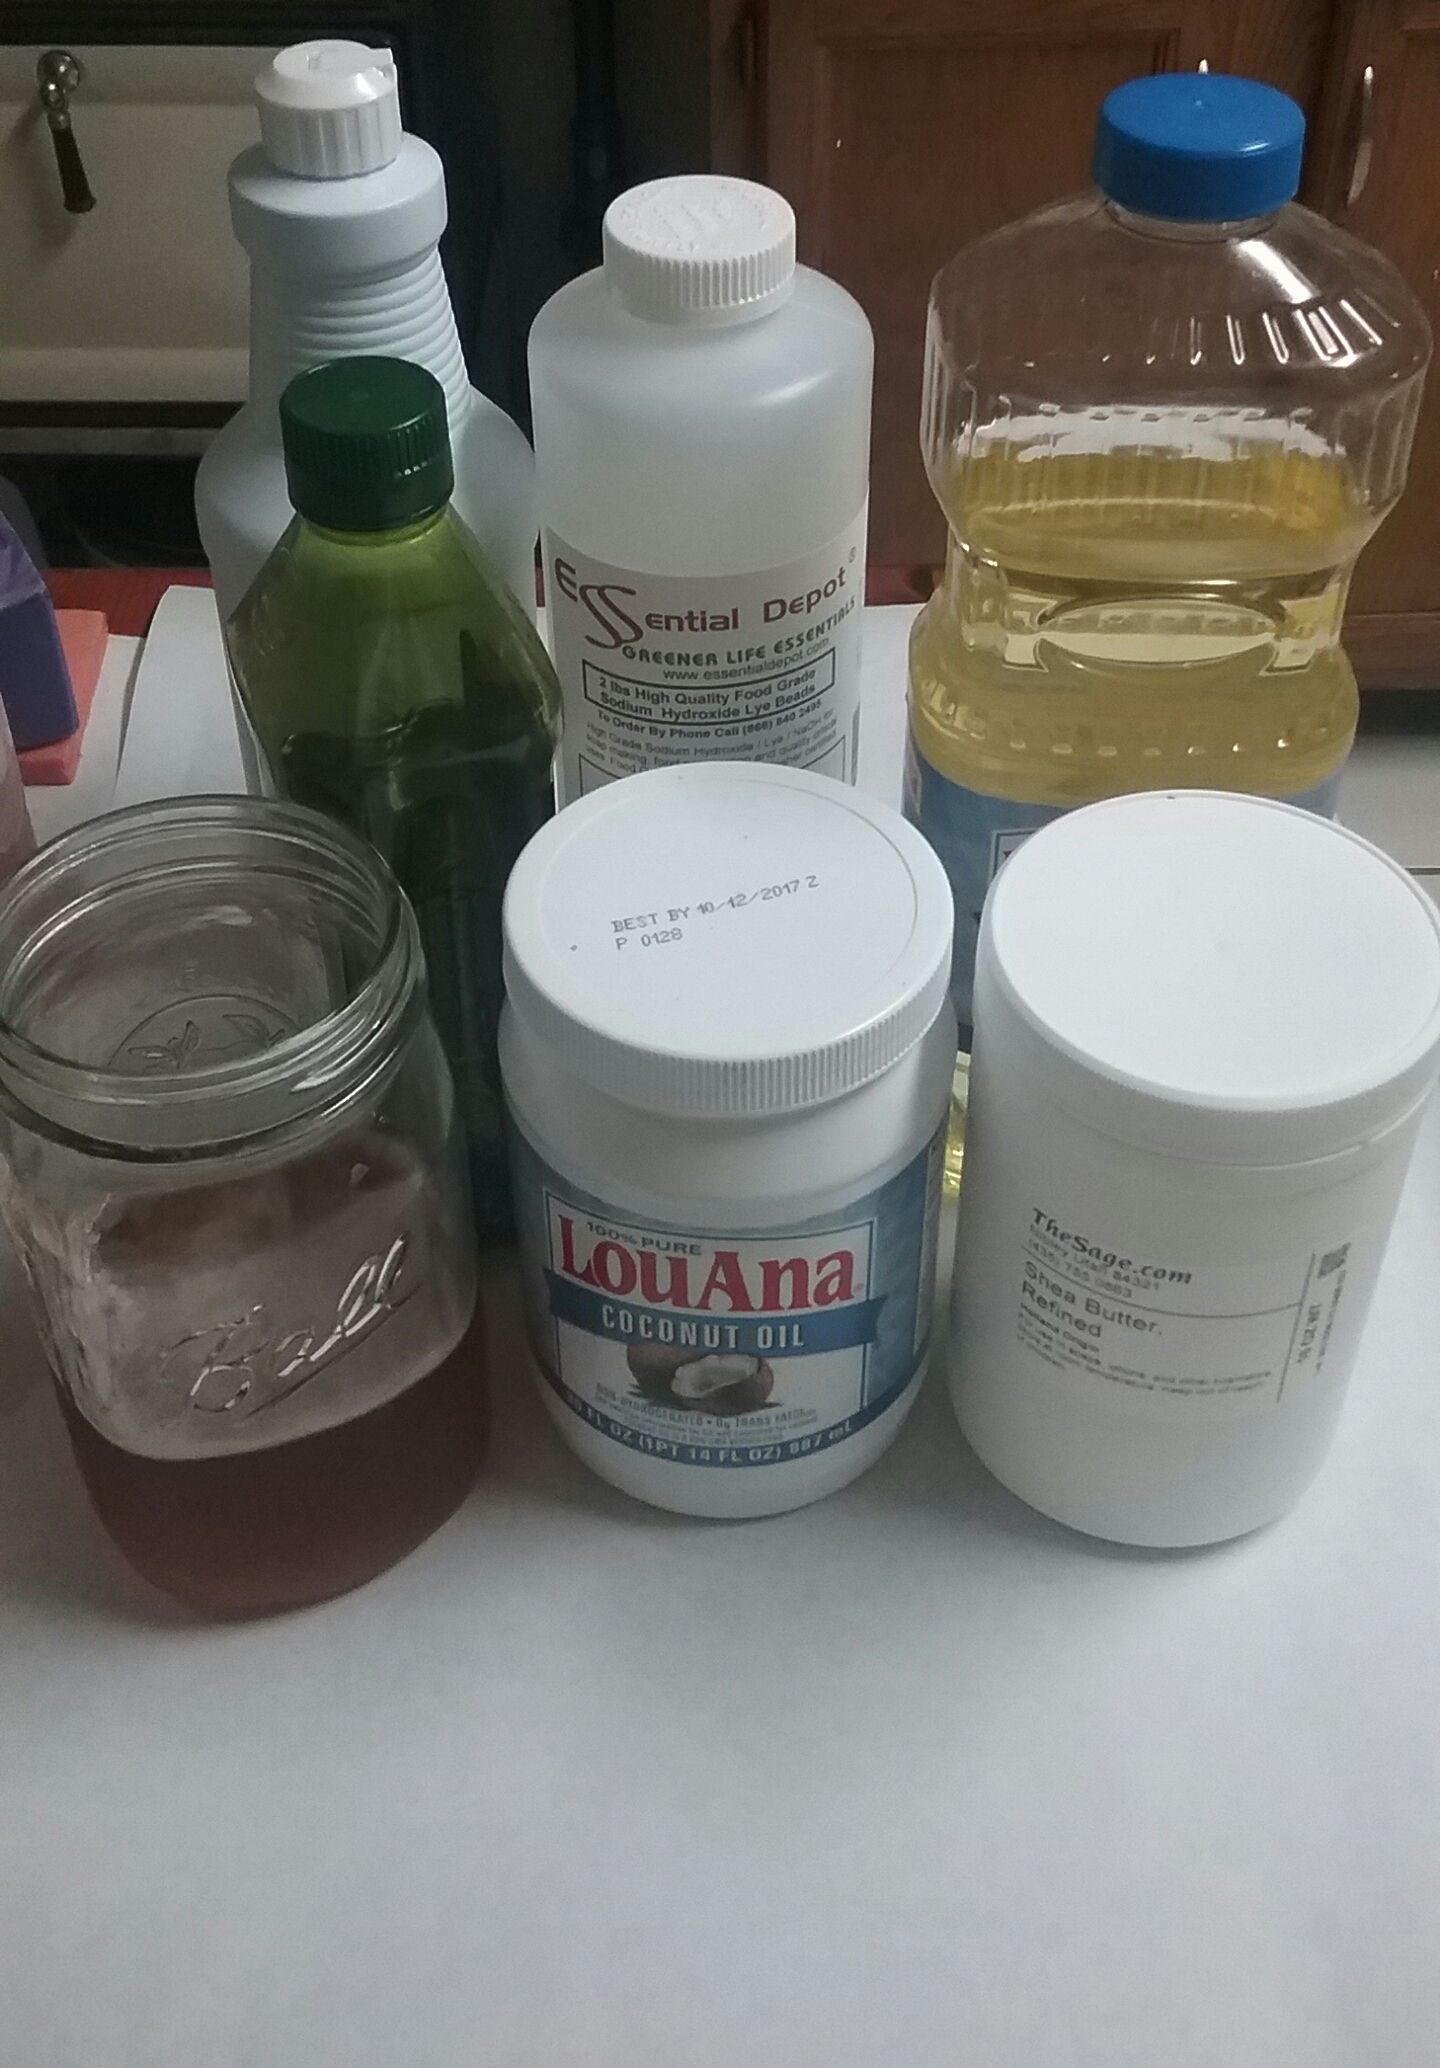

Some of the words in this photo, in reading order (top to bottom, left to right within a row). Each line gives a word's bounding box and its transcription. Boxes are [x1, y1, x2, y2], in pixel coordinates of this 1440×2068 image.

[763, 566, 847, 624] Depot
[621, 645, 718, 666] GREENER
[727, 645, 767, 666] LIFE
[773, 596, 856, 653] ESSENTIALS
[598, 676, 607, 689] 2
[610, 679, 631, 697] lbs
[635, 687, 670, 704] High
[675, 688, 730, 706] Quality
[734, 683, 772, 701] Food
[776, 668, 817, 691] Grade
[600, 691, 653, 716] Sodium
[662, 704, 741, 722] Hydroxide
[745, 702, 771, 716] Lye
[775, 684, 816, 708] Beads
[597, 709, 611, 723] To
[612, 717, 646, 733] Order
[649, 726, 666, 738] By
[670, 728, 711, 739] Phone
[714, 726, 739, 738] Call
[608, 731, 643, 751] Grade
[645, 742, 690, 756] Sodium
[694, 743, 754, 757] Hydroxide
[764, 734, 784, 748] Lye
[611, 913, 659, 933] BEST
[668, 906, 691, 922] BY
[805, 874, 820, 889] Z
[615, 937, 628, 951] P
[640, 927, 684, 948] 0128
[586, 1219, 638, 1246] 100%
[641, 1236, 702, 1256] PURE
[1031, 1206, 1194, 1286] TheSage.com
[558, 1213, 856, 1313] LouAna
[1024, 1259, 1077, 1304] Shea
[160, 1230, 412, 1413] Ball
[602, 1304, 739, 1349] COCONUT
[757, 1325, 805, 1349] OIL
[1020, 1280, 1102, 1338] Refined
[609, 1423, 632, 1441] OZ
[638, 1434, 680, 1457] (1PT
[690, 1448, 710, 1462] 14
[719, 1450, 740, 1463] FL
[748, 1446, 782, 1461] OZ)
